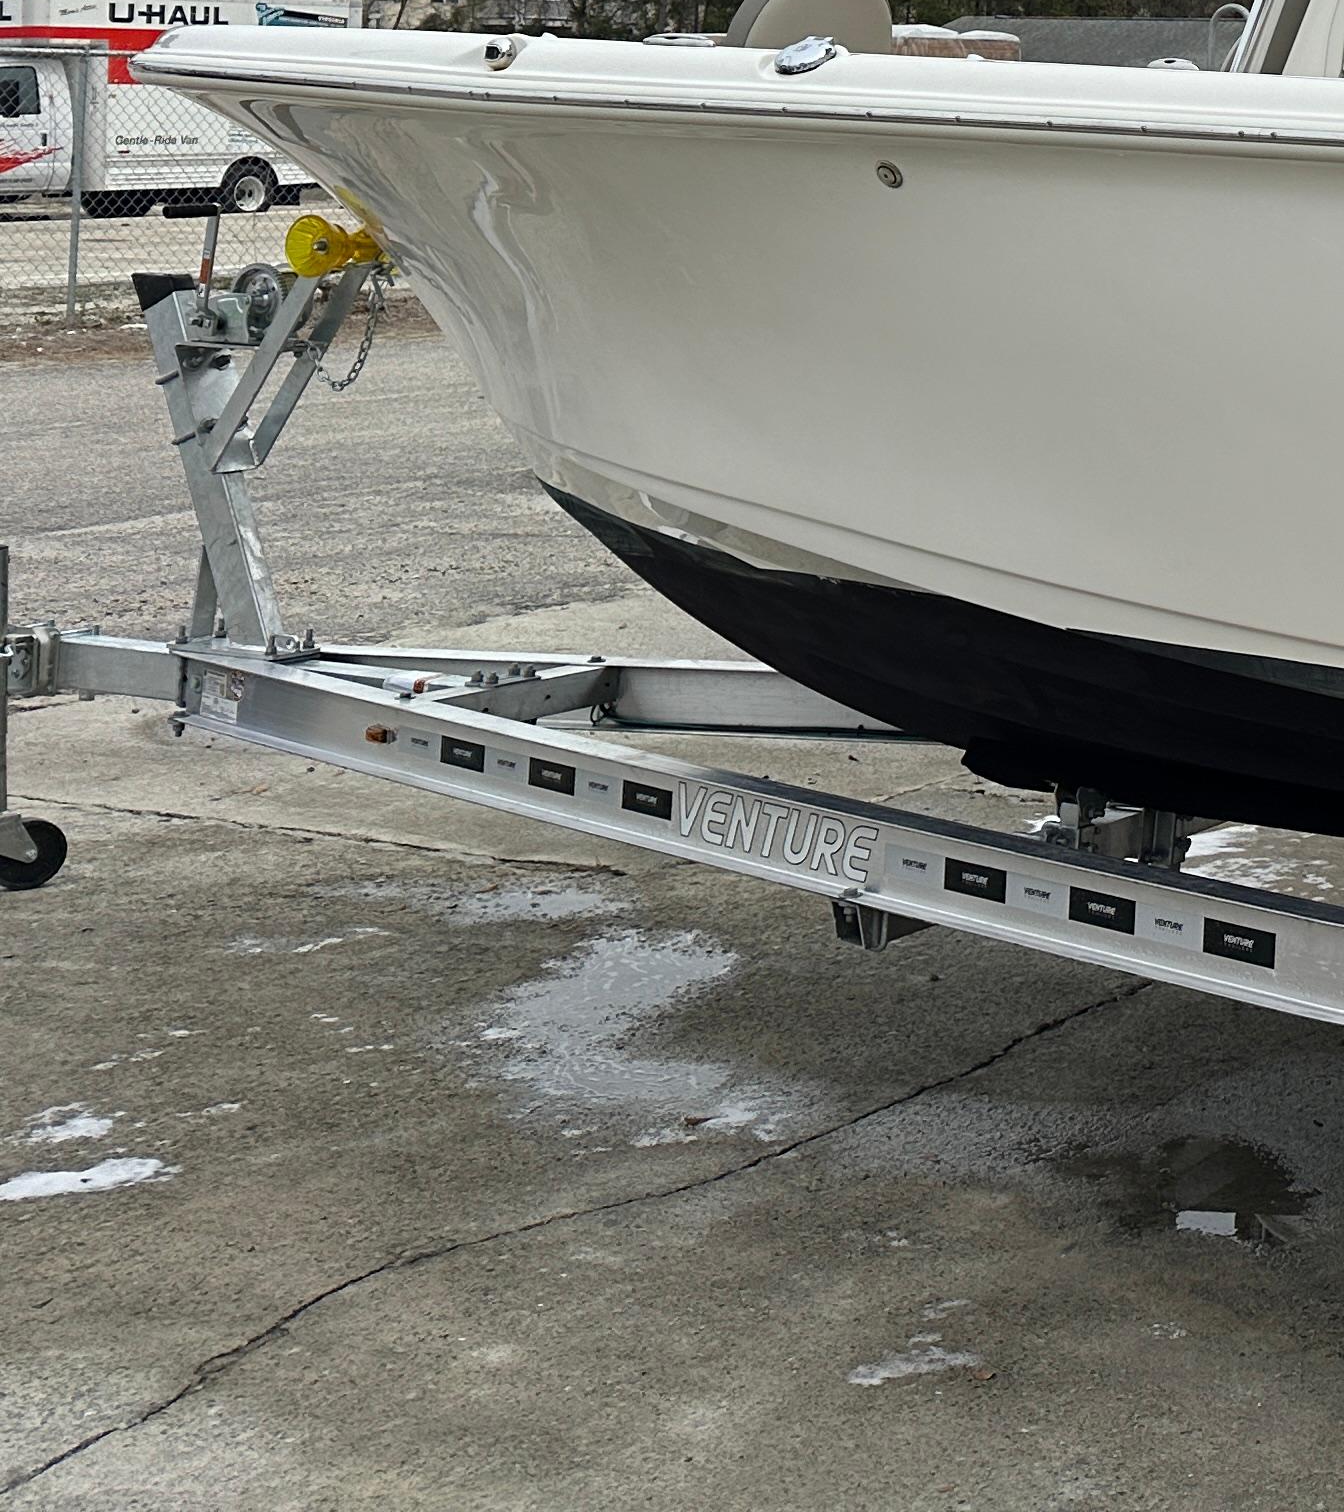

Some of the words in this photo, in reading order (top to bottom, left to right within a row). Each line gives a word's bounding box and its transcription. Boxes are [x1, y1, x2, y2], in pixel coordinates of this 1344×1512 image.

[108, 2, 229, 25] U-HAUL
[180, 135, 199, 145] Van
[678, 781, 880, 883] VENTURE
